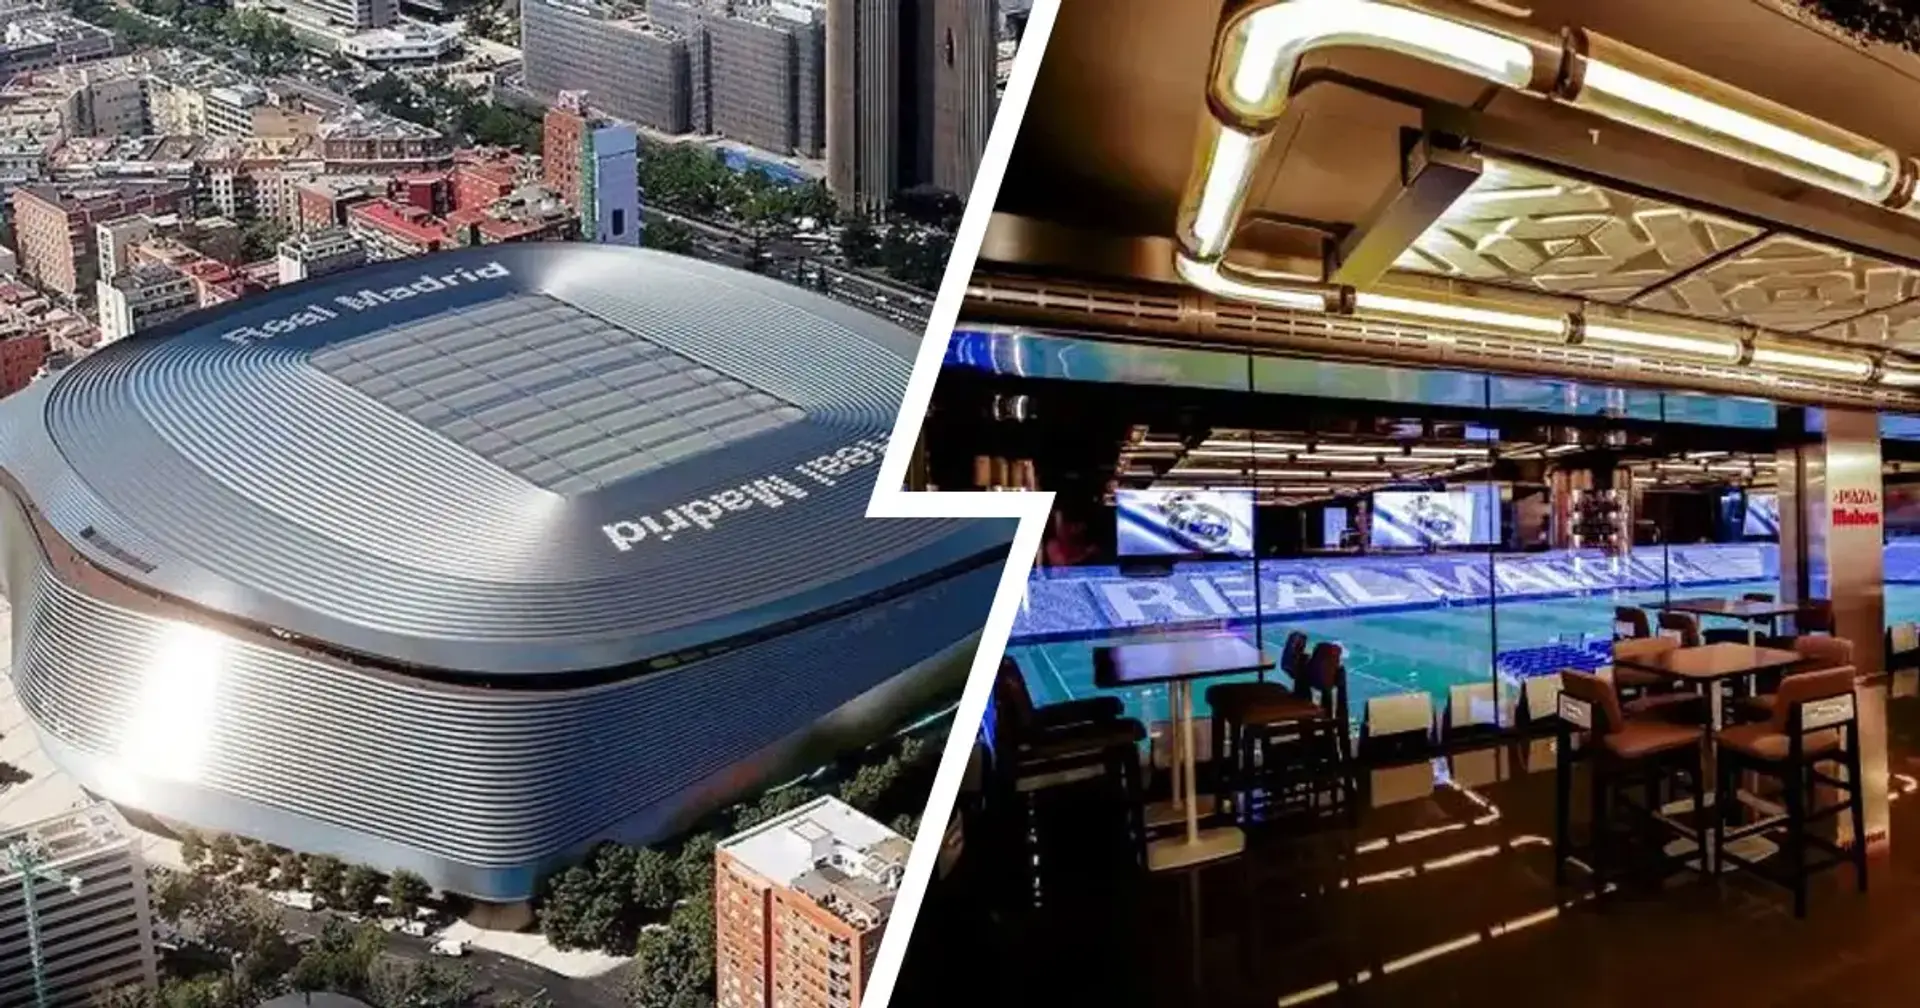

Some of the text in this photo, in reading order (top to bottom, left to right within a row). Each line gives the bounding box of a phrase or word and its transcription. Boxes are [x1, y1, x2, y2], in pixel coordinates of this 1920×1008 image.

[334, 260, 510, 311] Madrid
[602, 475, 809, 551] Madrid
[1101, 572, 1412, 621] REAL
